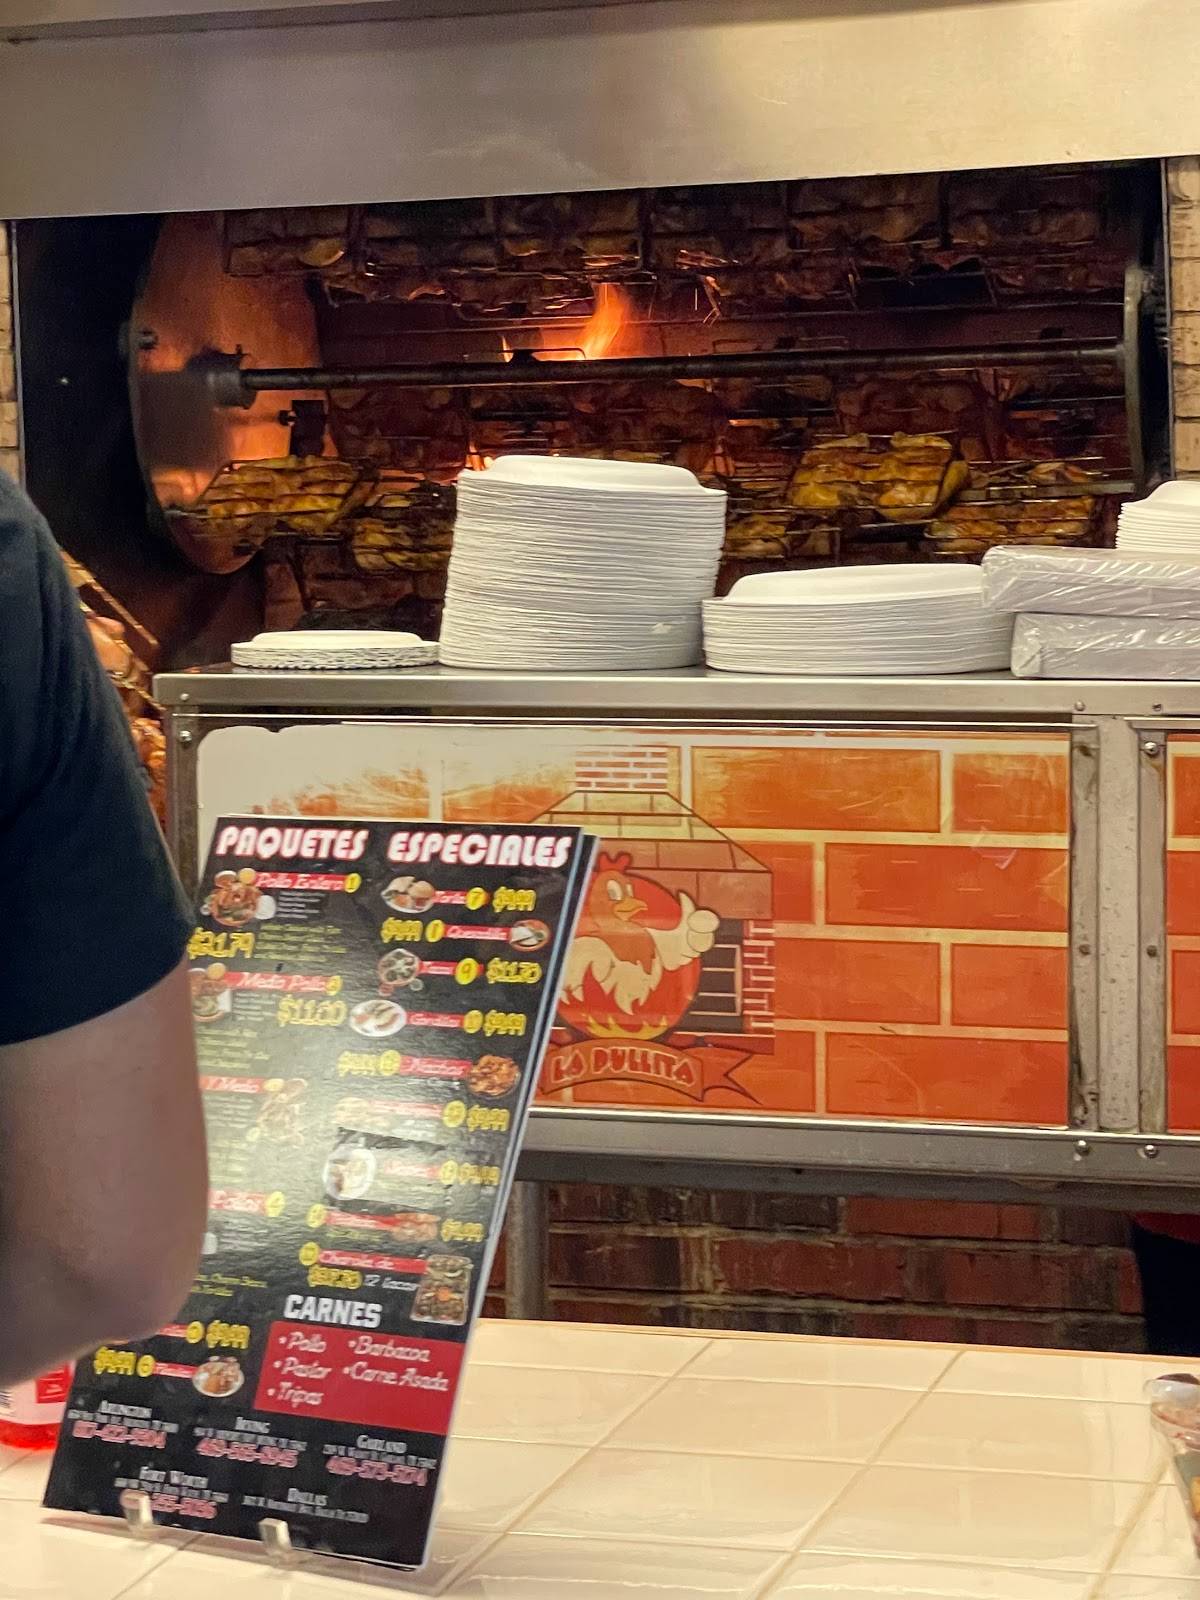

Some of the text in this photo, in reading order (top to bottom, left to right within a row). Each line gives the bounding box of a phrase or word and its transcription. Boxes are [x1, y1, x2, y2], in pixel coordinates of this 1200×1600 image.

[216, 826, 573, 868] PAQUETES ESPECIALES
[552, 1048, 587, 1085] LA
[284, 1294, 383, 1328] CARNES
[287, 1332, 327, 1353] Pollo
[354, 1335, 430, 1362] Barbacoa
[281, 1357, 332, 1379] Pastor
[350, 1361, 449, 1391] Carne Asada
[277, 1382, 324, 1408] Tripas
